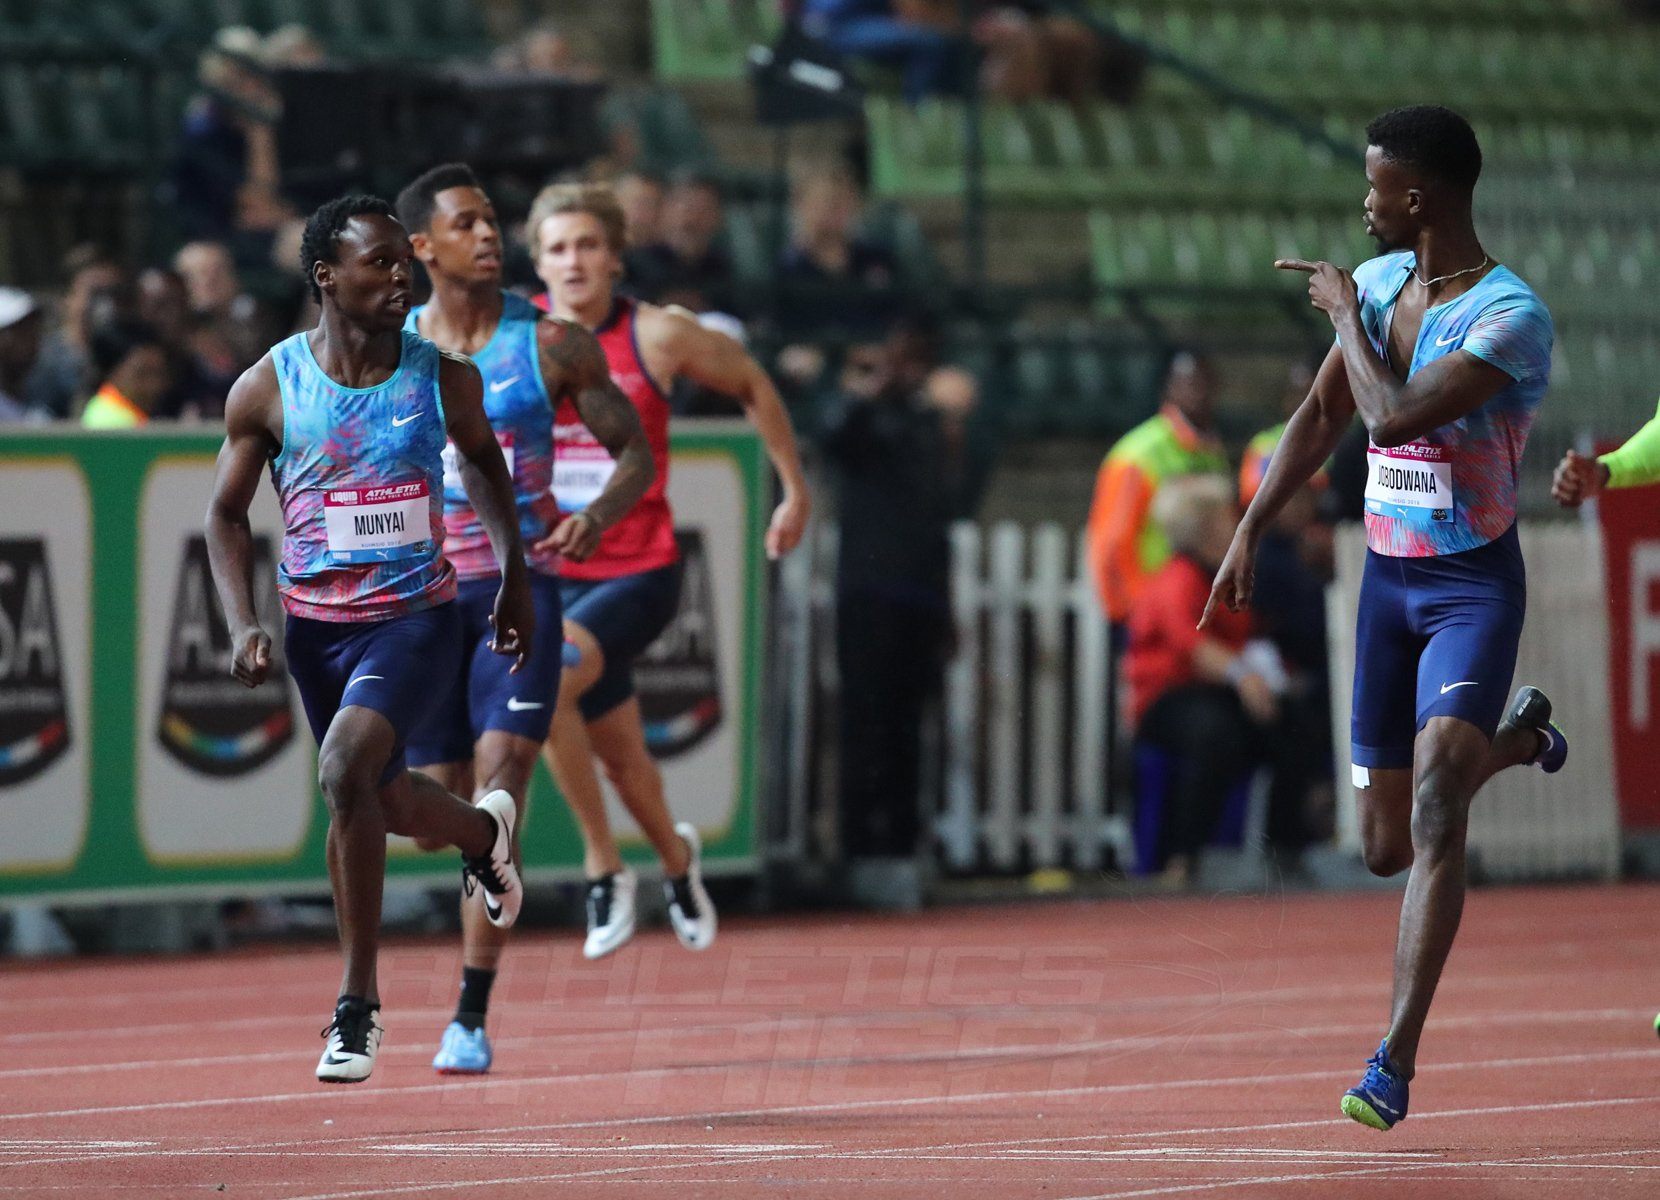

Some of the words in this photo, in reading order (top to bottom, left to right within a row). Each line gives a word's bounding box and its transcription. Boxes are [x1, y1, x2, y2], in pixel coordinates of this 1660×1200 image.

[365, 483, 422, 497] ATHLETIX
[1378, 464, 1437, 494] JOBODWANA
[354, 511, 405, 536] MUNYAI
